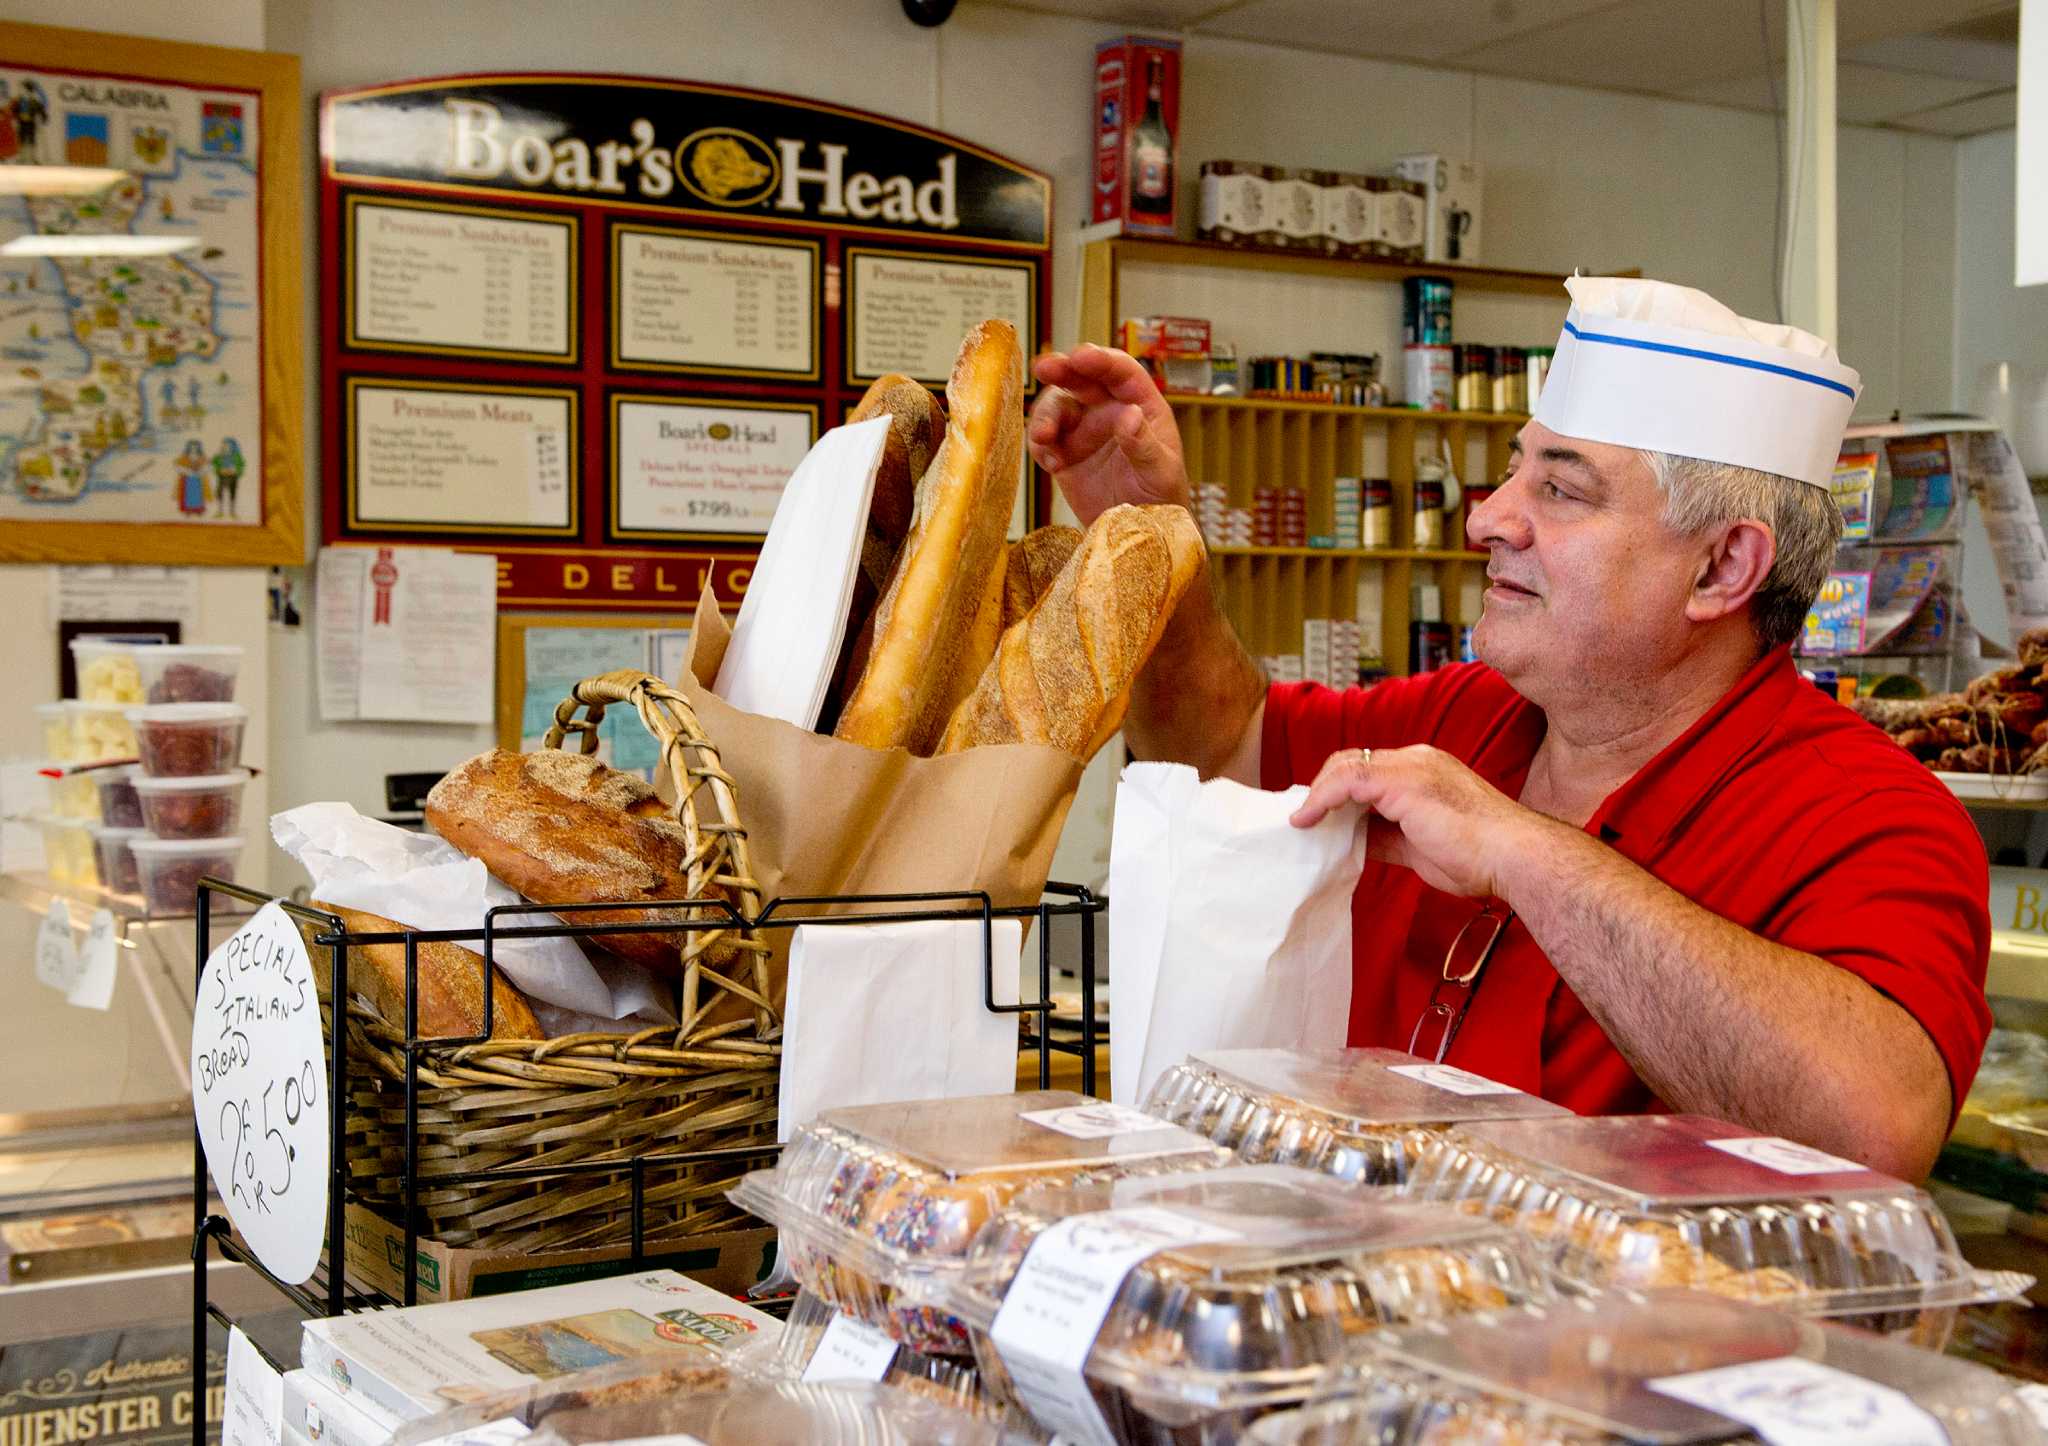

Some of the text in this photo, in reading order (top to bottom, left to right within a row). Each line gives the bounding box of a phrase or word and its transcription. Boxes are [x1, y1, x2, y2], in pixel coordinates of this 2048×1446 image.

[444, 99, 960, 230] Boar's Head
[393, 399, 533, 423] Premium Meats
[733, 424, 777, 444] Head
[214, 931, 306, 1013] SPECIALS
